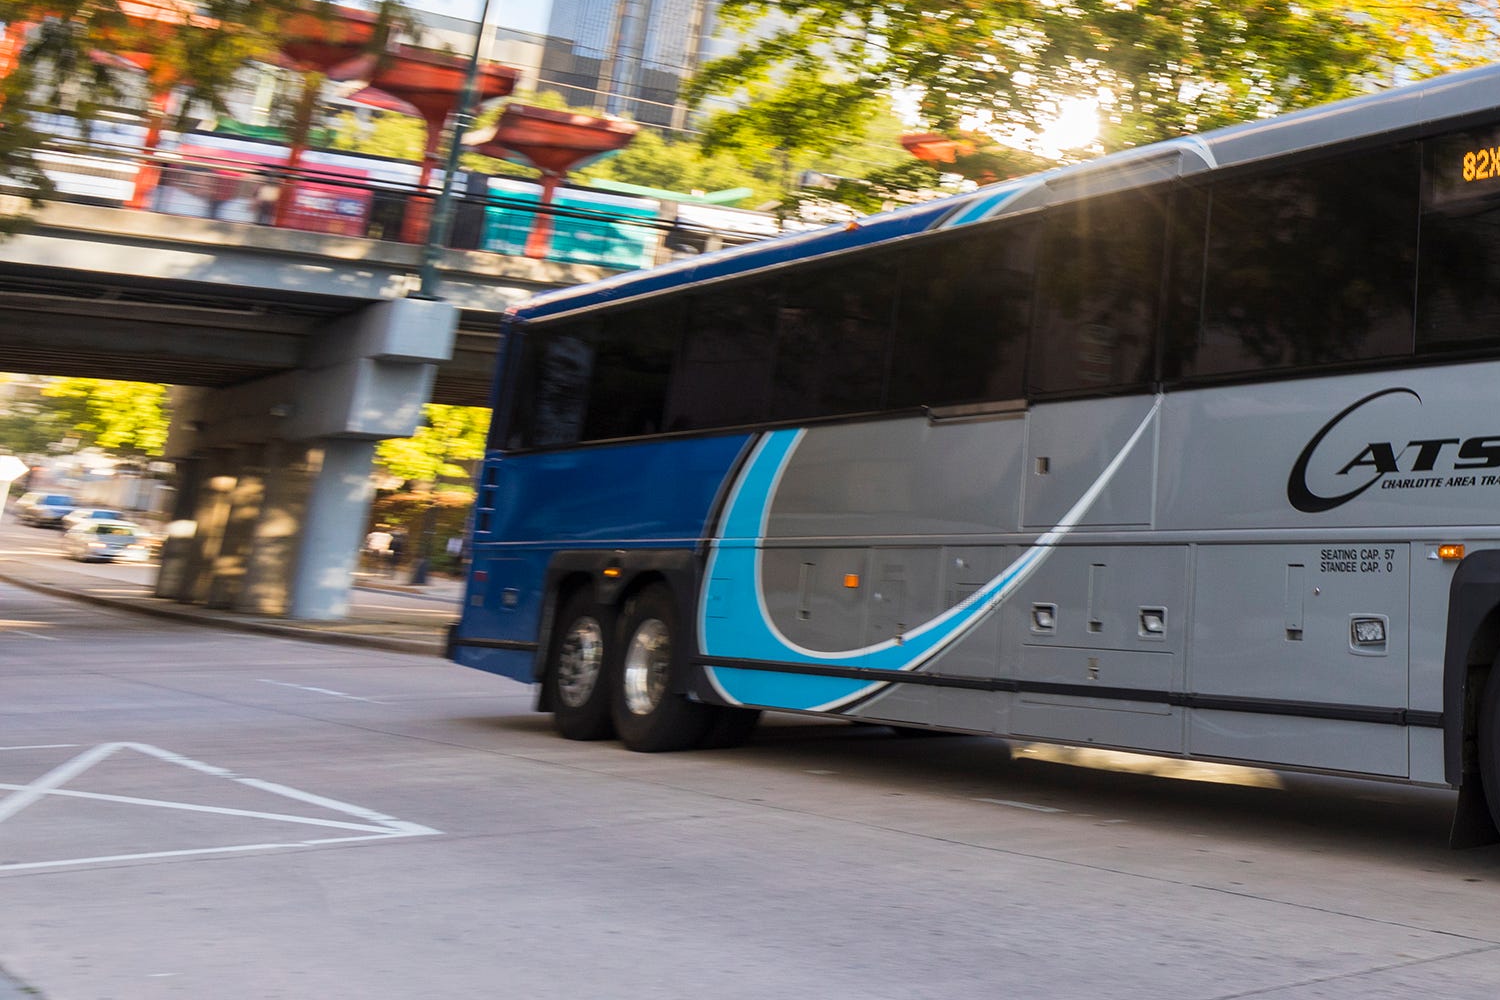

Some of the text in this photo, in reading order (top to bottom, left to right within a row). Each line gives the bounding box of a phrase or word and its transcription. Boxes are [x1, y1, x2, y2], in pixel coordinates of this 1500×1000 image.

[1381, 477, 1444, 489] CHARLOTTE
[1446, 475, 1476, 487] AREA
[1320, 548, 1395, 560] SEATING CAP. 57
[1320, 561, 1393, 573] STANDEE CAP. 0
